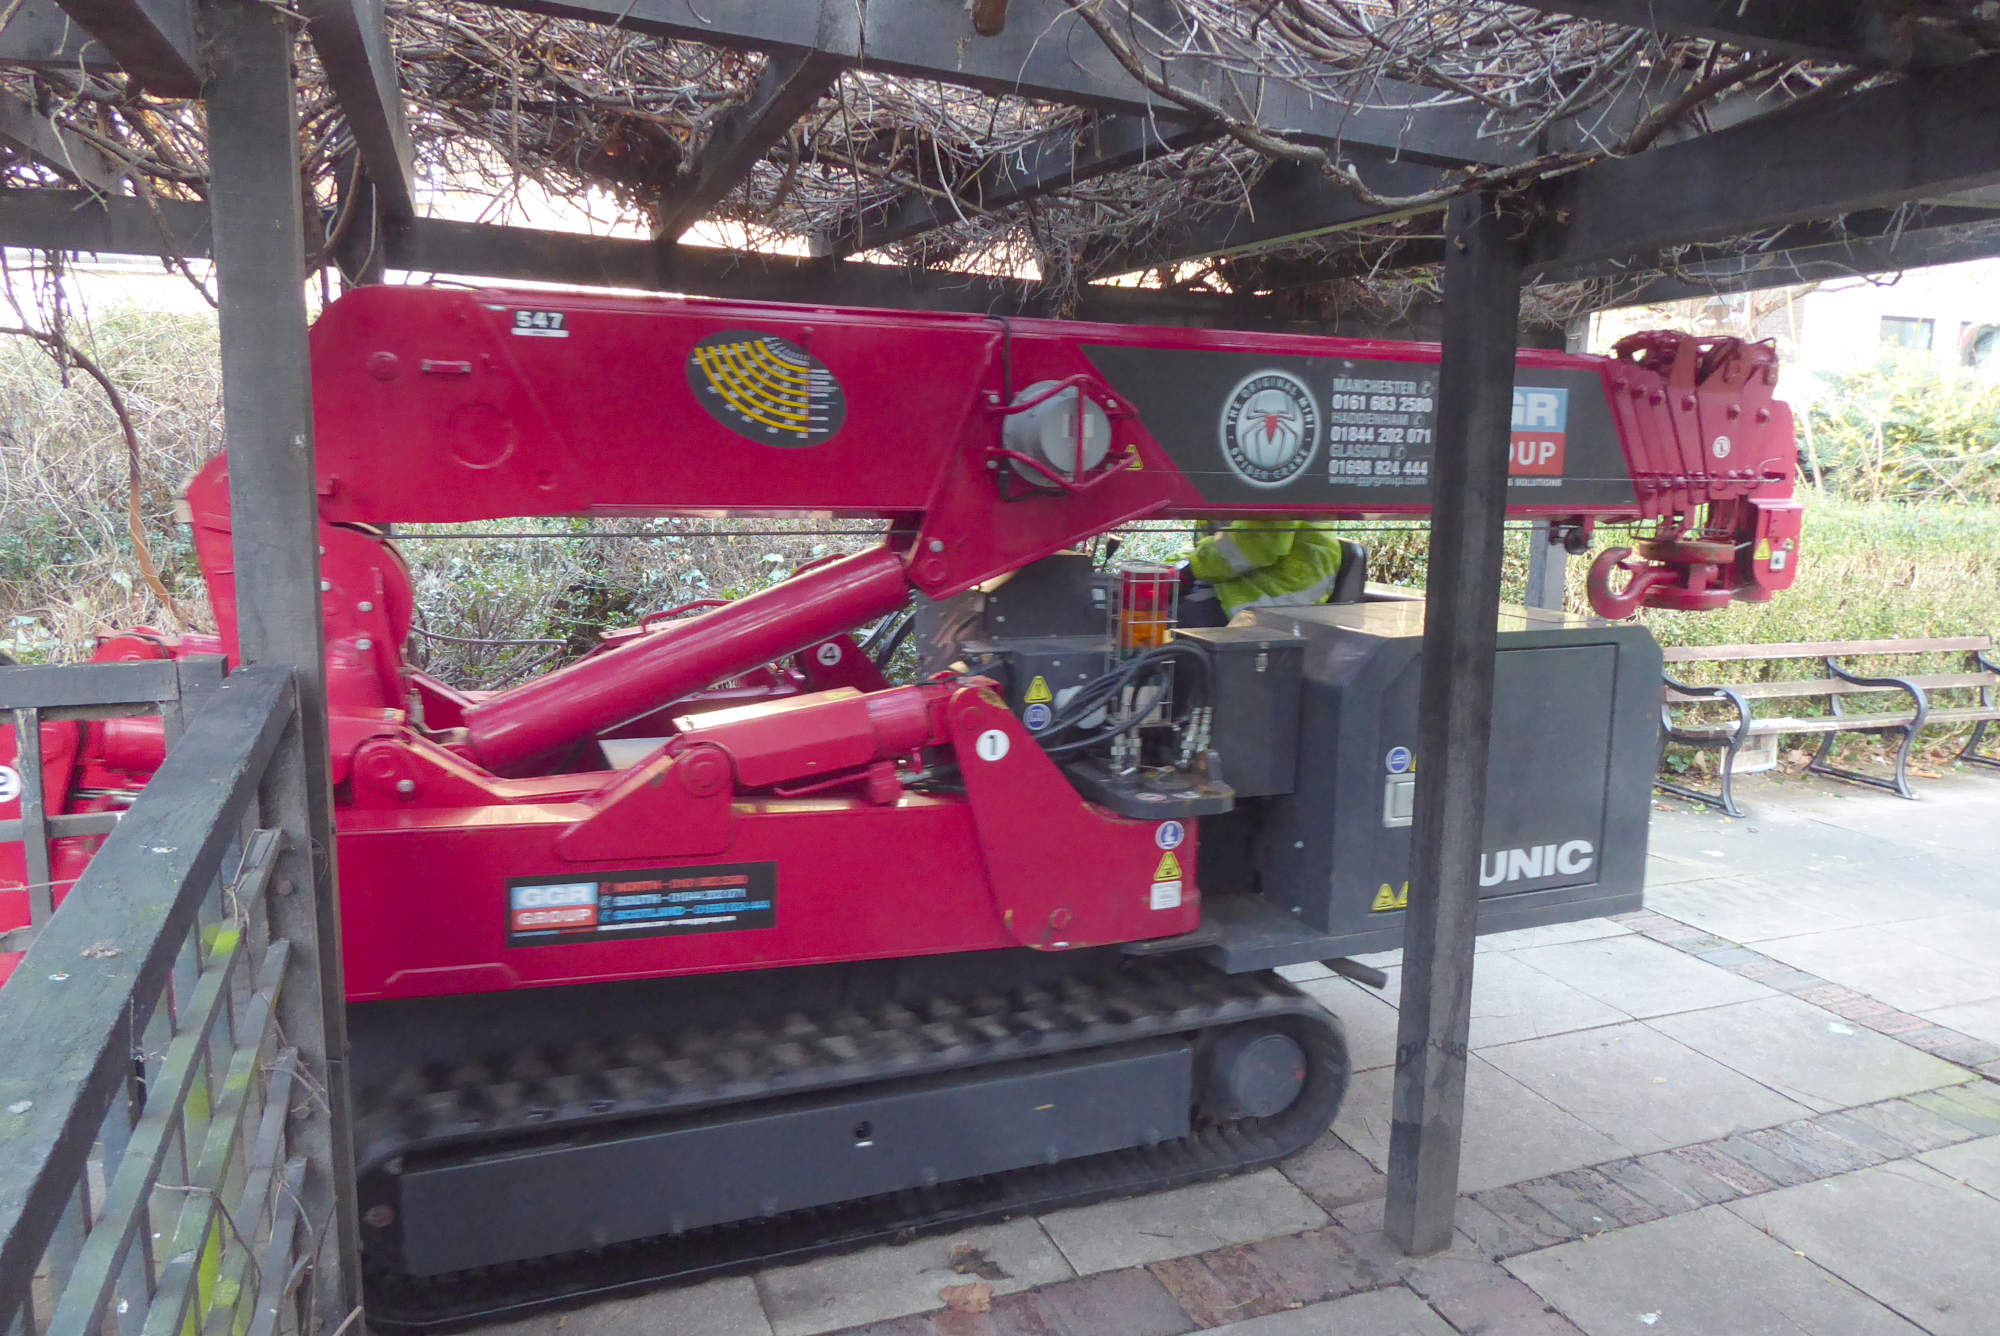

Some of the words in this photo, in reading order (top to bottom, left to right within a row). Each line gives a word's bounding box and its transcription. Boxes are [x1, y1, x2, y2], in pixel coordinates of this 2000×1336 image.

[516, 311, 564, 328] 547
[1333, 378, 1417, 394] MANCHESTER
[1332, 394, 1366, 410] 0161
[1330, 426, 1375, 442] 01844
[1406, 428, 1432, 443] 071
[1329, 444, 1391, 458] GLASGOW
[1403, 461, 1428, 475] 444
[823, 646, 837, 662] 4
[1479, 839, 1594, 887] UNIC
[520, 886, 591, 907] GGR
[517, 908, 592, 925] GROUP
